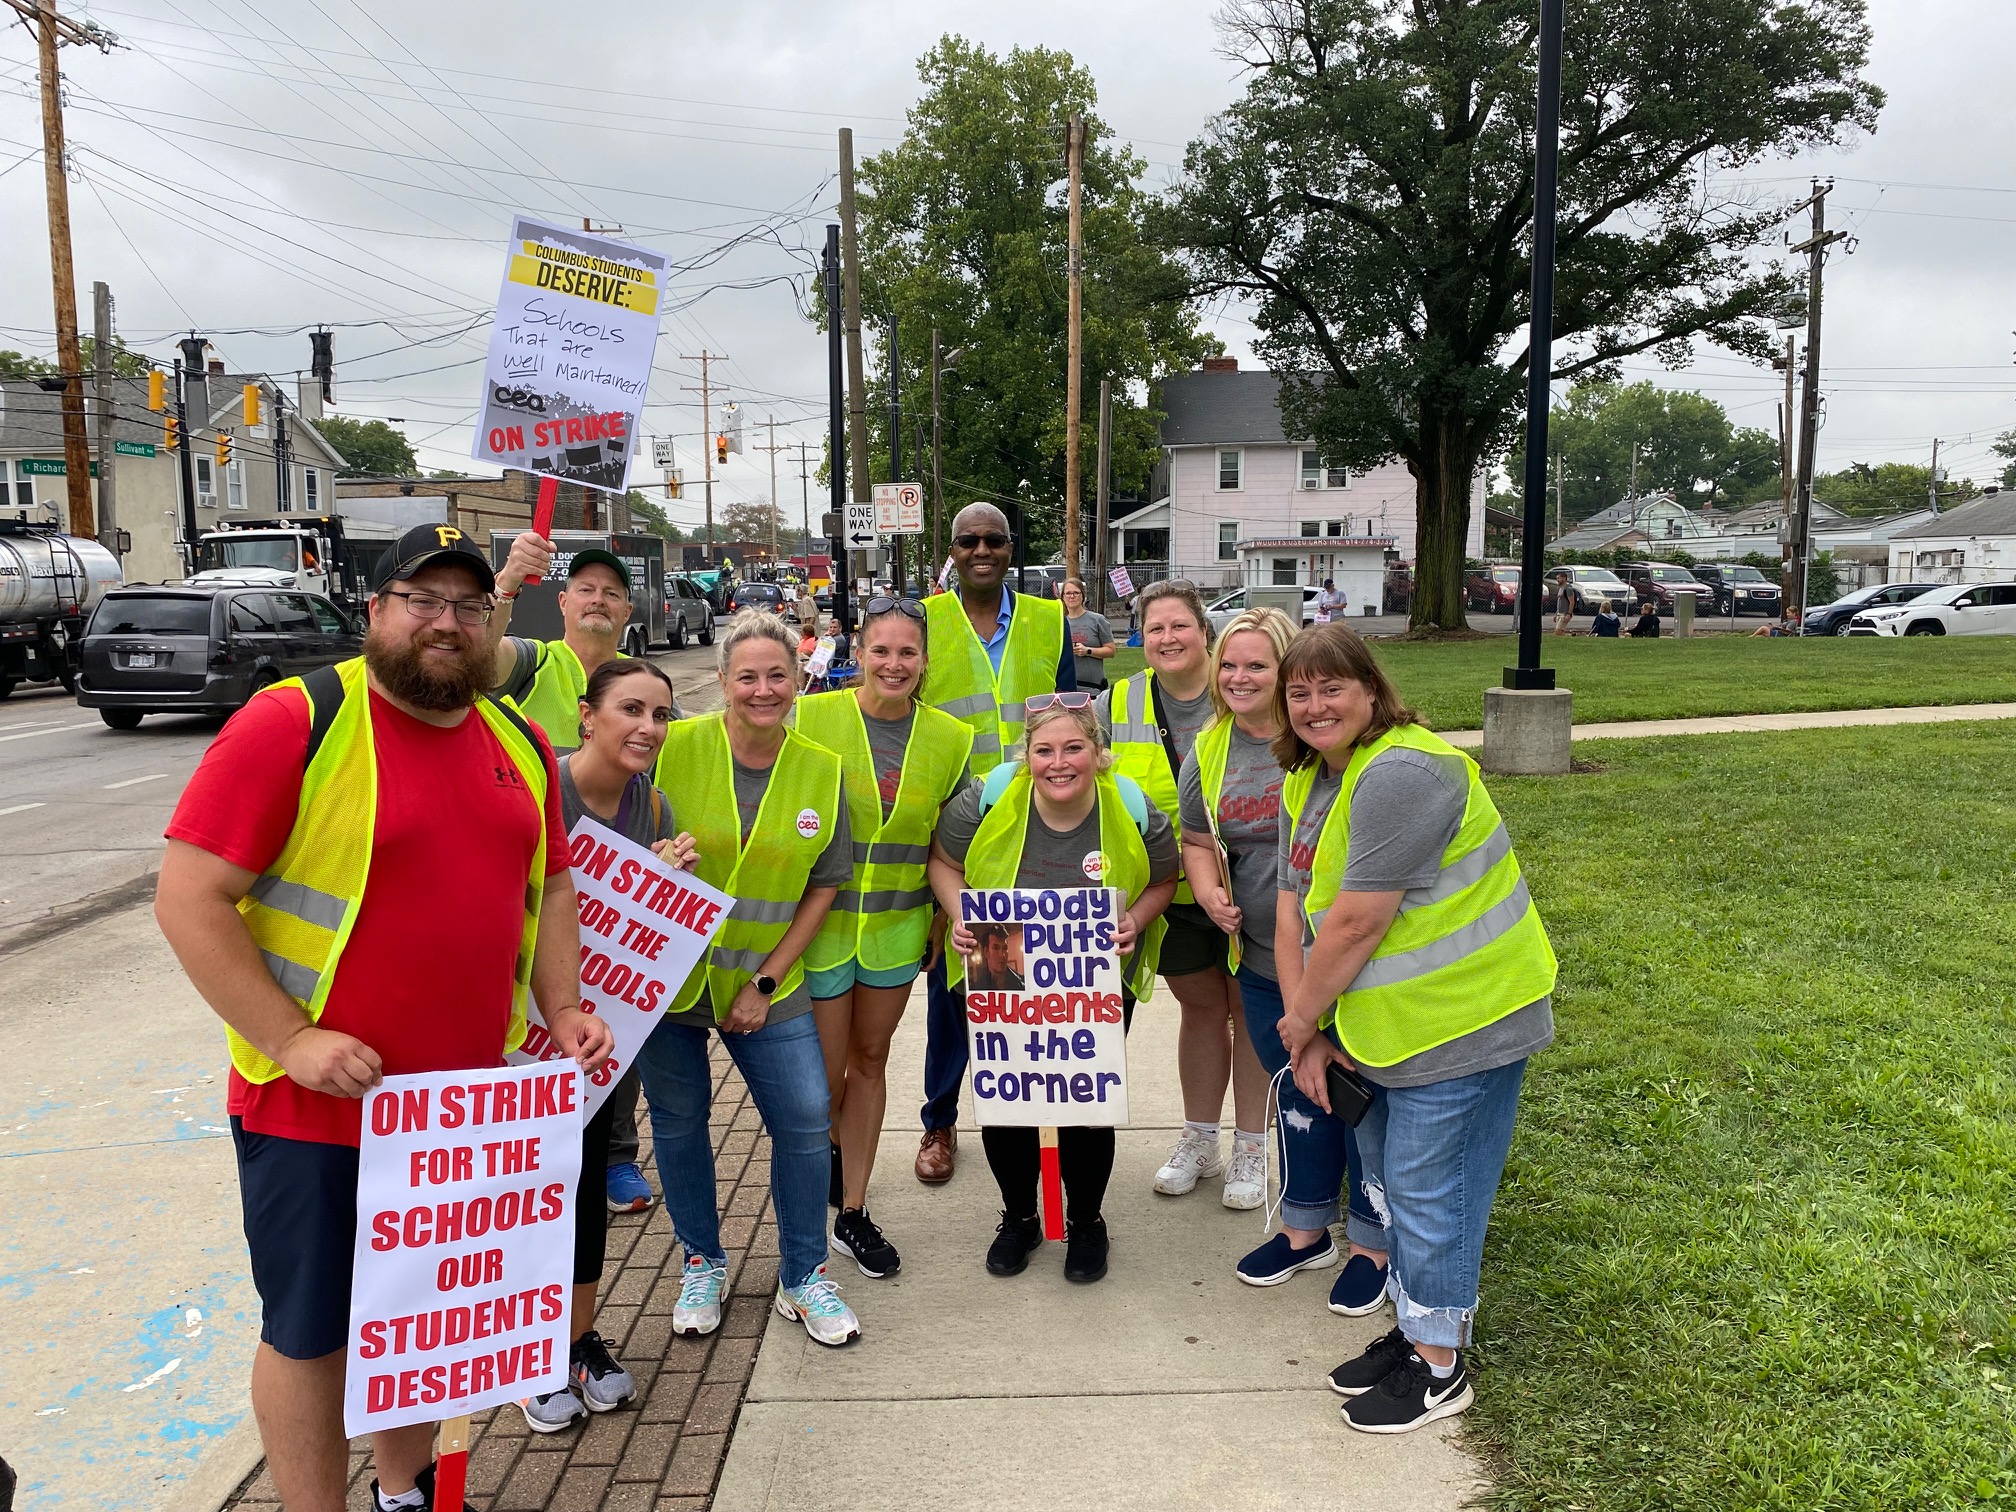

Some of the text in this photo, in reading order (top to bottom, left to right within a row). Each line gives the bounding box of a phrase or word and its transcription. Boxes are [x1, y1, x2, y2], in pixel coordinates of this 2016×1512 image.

[535, 244, 643, 283] COLUMBUS STUDENTS
[536, 262, 632, 307] DESERVE:
[502, 325, 594, 358] That are
[495, 387, 546, 412] cea
[116, 441, 145, 455] Sullivant
[489, 411, 627, 454] ON STRIKE
[848, 519, 874, 530] WAY
[849, 507, 873, 518] ONE
[434, 526, 463, 547] P
[798, 820, 819, 830] cea
[569, 833, 722, 937] ON STRIKE
[618, 918, 670, 962] THE
[1033, 956, 1111, 988] our
[975, 1028, 1096, 1061] in the
[371, 1071, 577, 1136] ON STRIKE
[410, 1137, 541, 1187] FOR THE
[371, 1183, 565, 1252] SCHOOLS
[436, 1248, 504, 1293] OUR
[359, 1283, 563, 1360] STUDENTS
[366, 1337, 554, 1415] DESERVE!
